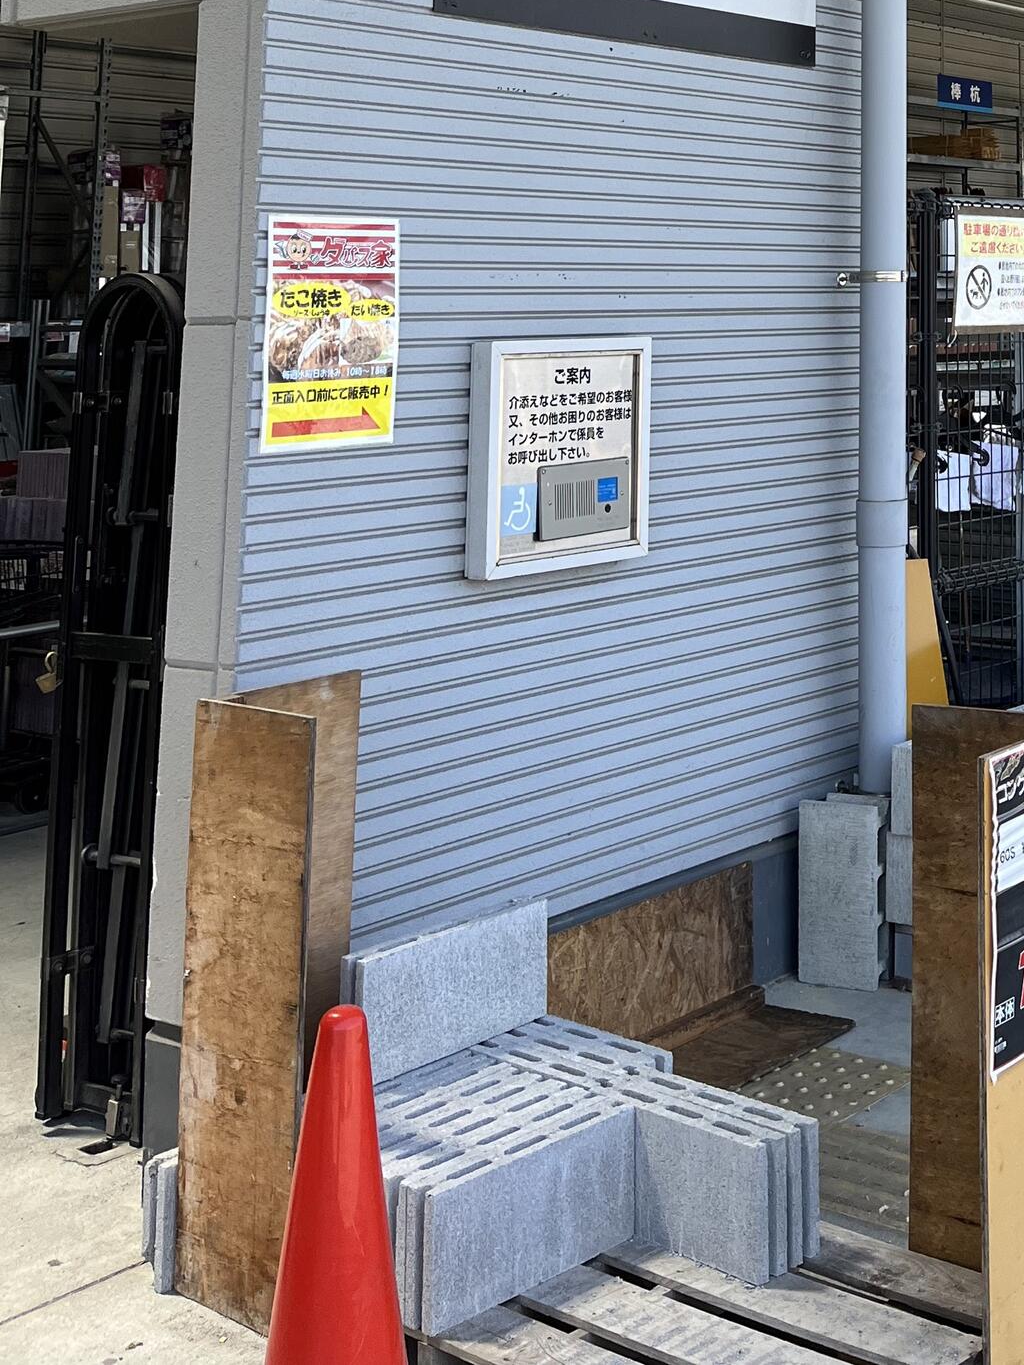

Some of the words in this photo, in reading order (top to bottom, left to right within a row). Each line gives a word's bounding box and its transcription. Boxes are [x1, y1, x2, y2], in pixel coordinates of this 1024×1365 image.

[280, 288, 342, 309] たこ焼き
[554, 367, 591, 384] ご案内
[508, 389, 633, 410] 介添えなどをご希望のお客様
[508, 407, 632, 428] 又、その他お困りのお客様は
[507, 426, 604, 446] インターホンで係員を
[507, 447, 591, 465] お呼び出し下さい。
